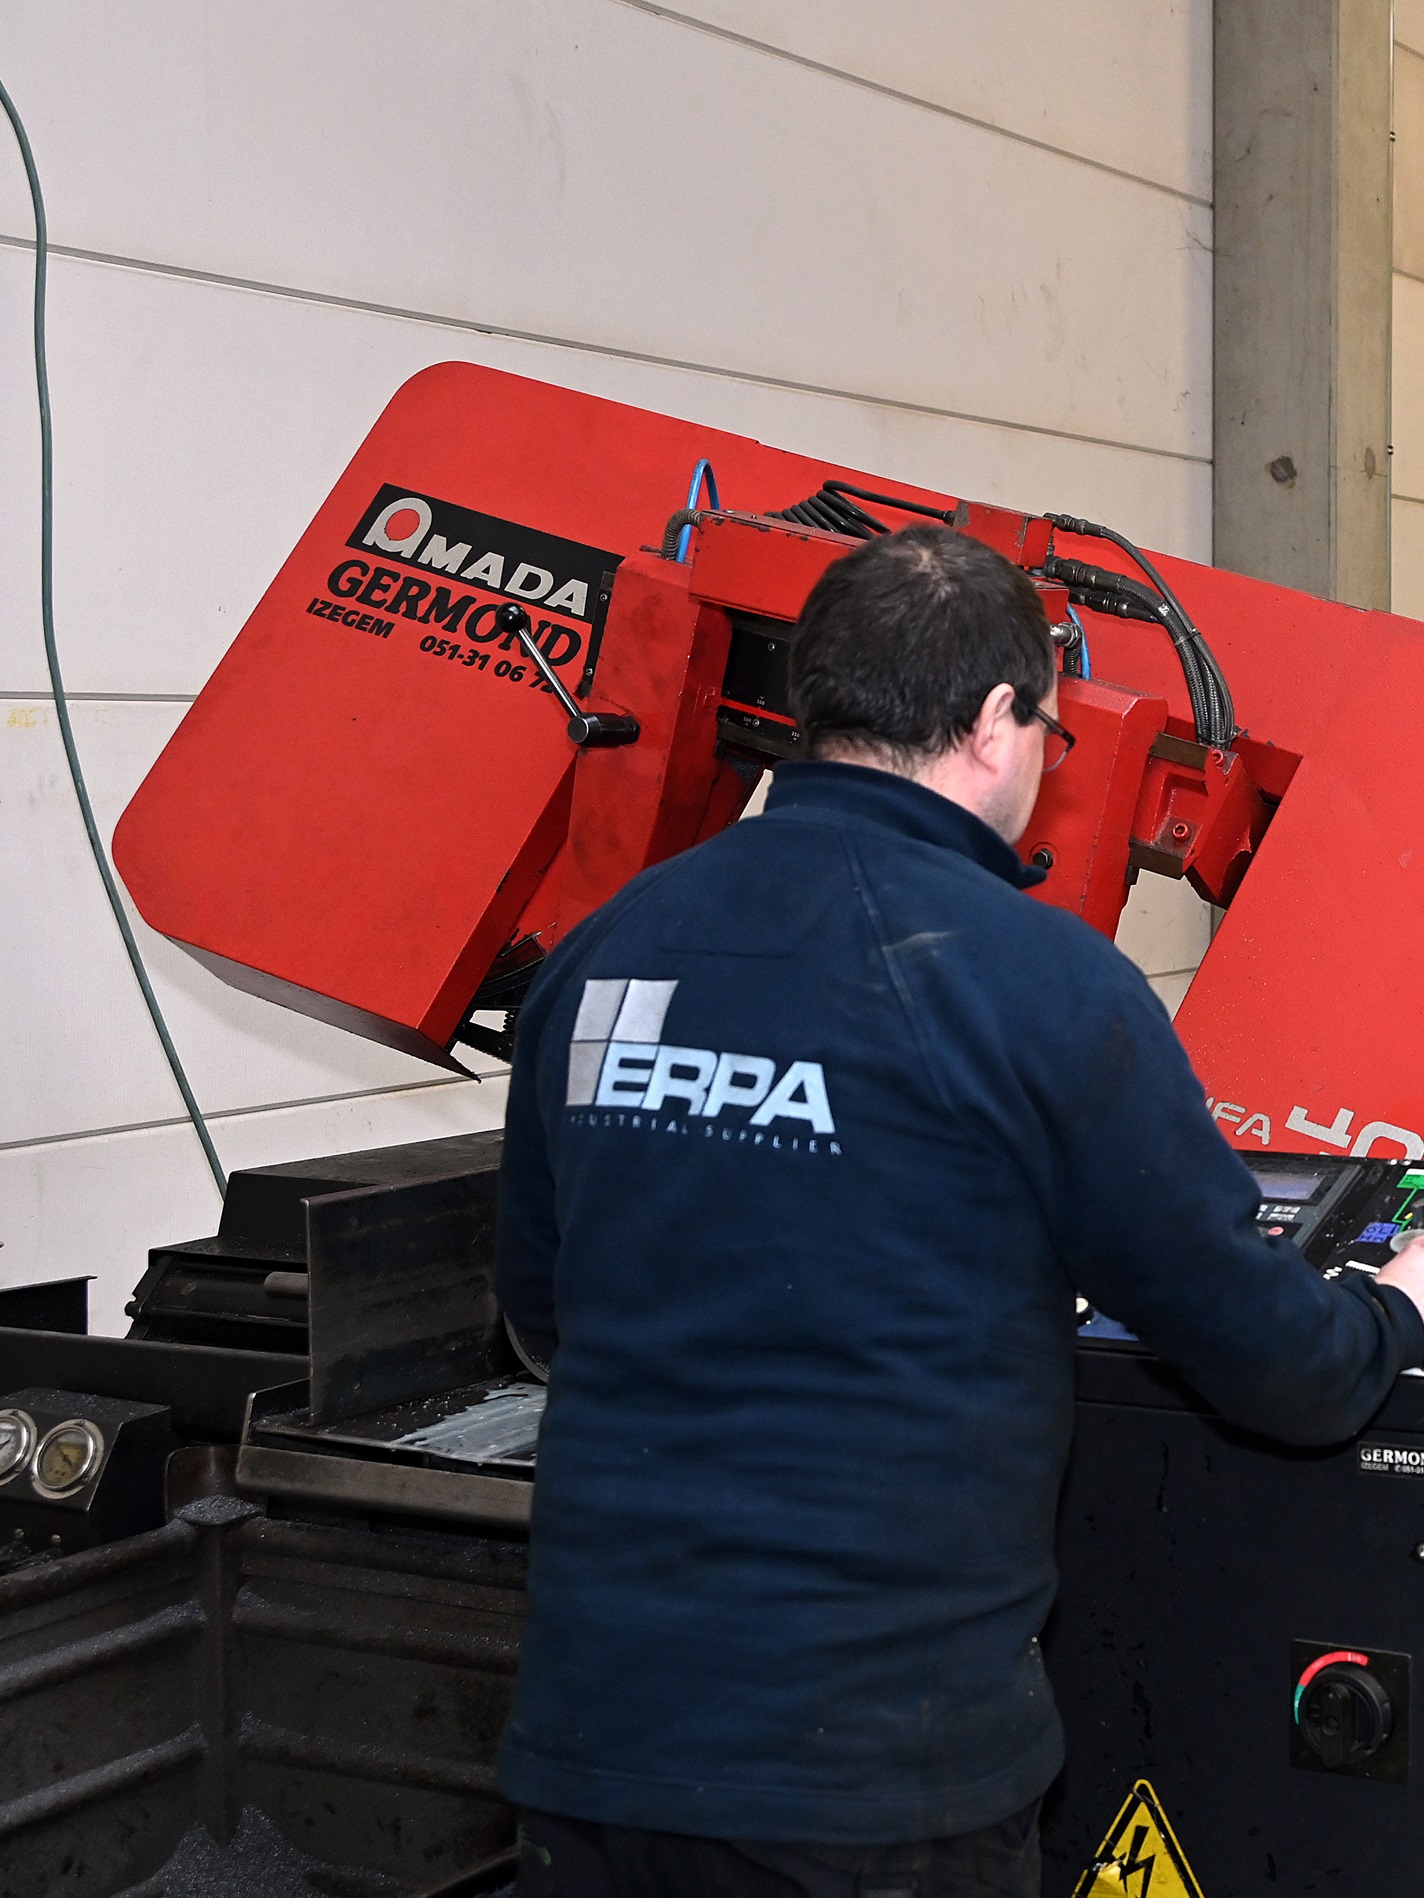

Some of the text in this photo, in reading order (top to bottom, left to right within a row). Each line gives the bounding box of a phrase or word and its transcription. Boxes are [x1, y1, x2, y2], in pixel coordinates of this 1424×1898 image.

[361, 497, 590, 617] AMADA
[305, 598, 396, 639] IZEGEM
[419, 634, 490, 671] 051-31
[494, 660, 527, 682] 06
[595, 1041, 836, 1134] ERPA
[704, 1123, 842, 1156] SUPPLIER
